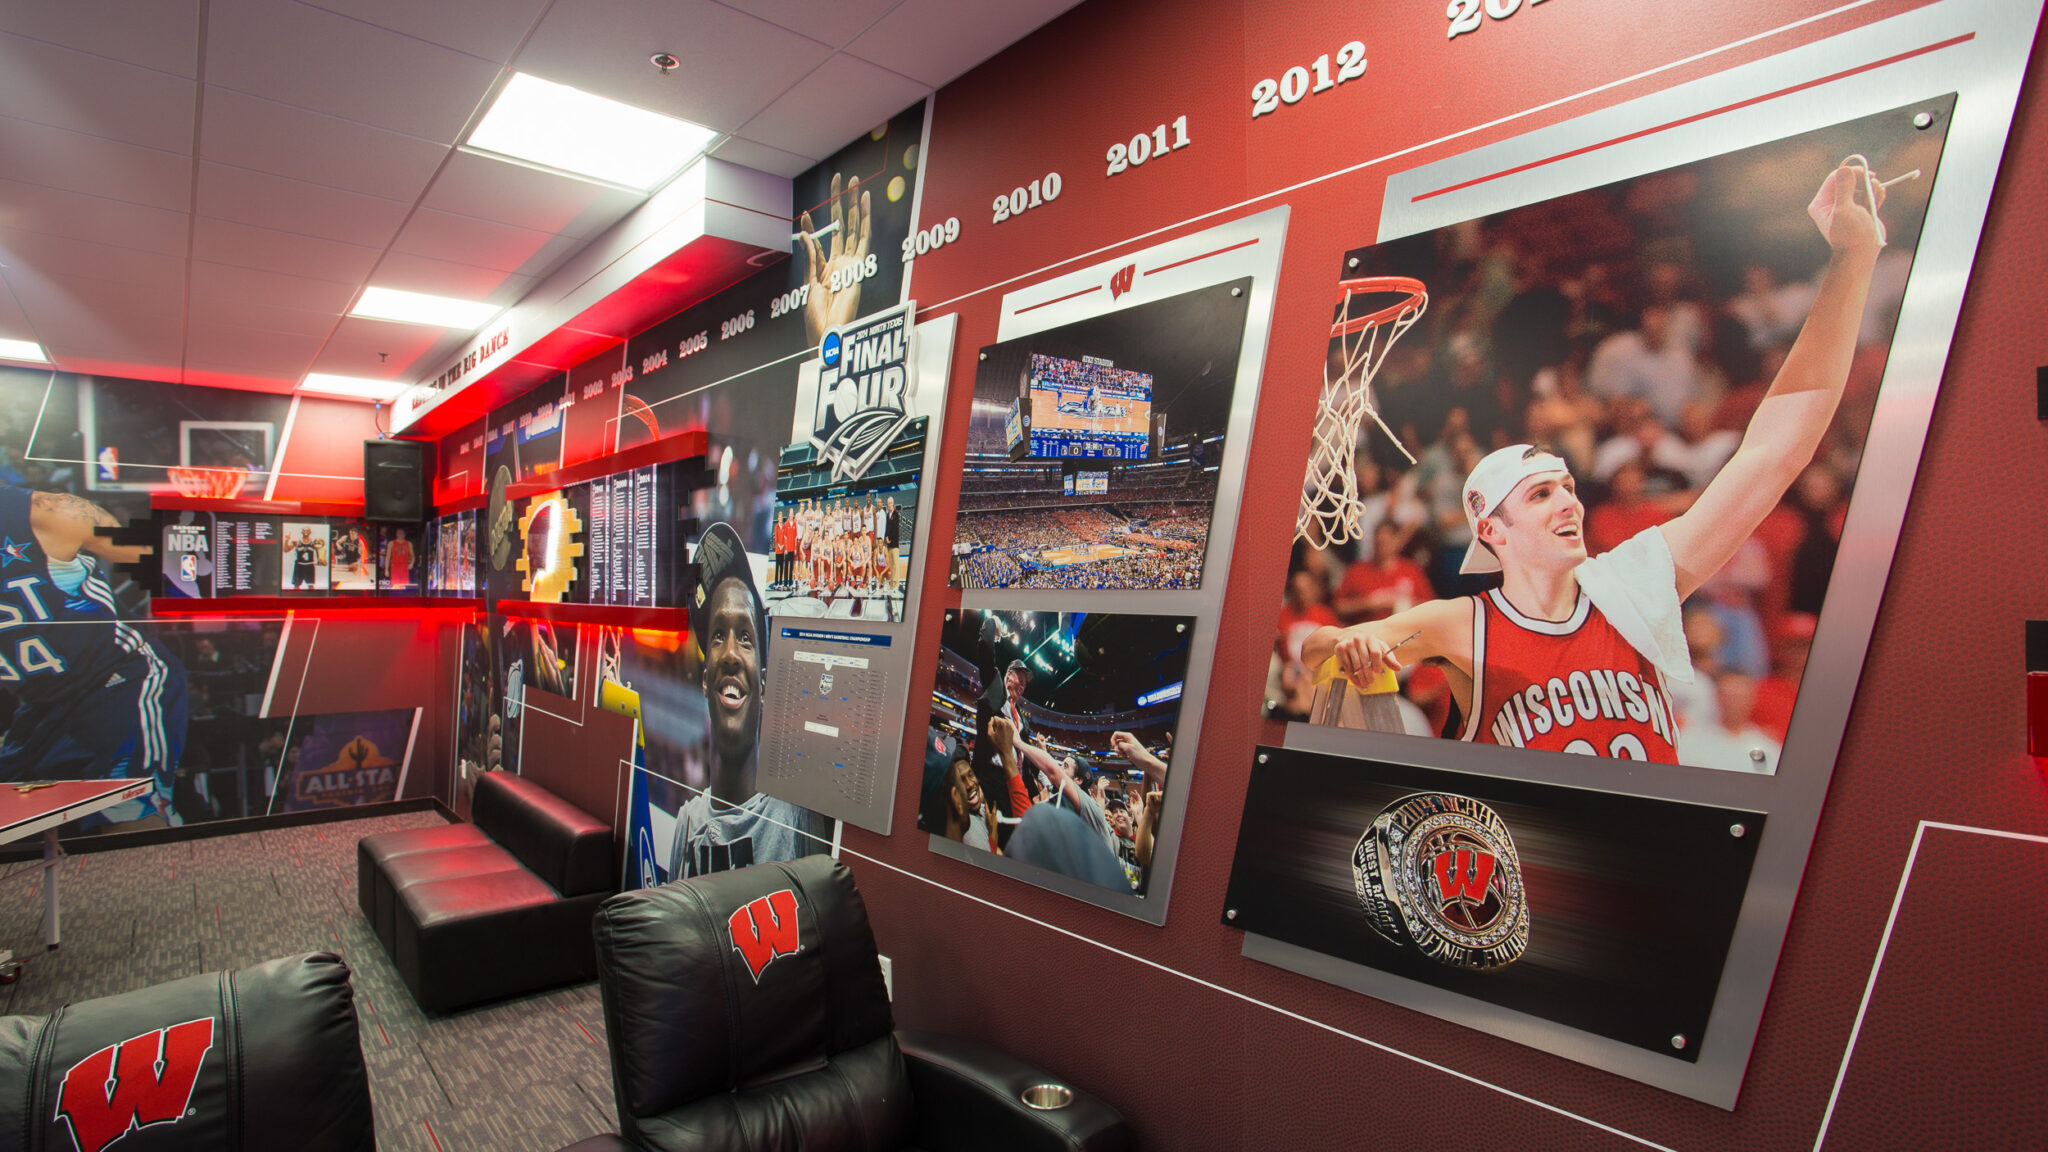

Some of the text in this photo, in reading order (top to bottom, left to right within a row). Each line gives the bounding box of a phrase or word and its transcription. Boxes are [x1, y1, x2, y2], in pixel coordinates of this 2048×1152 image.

[1252, 40, 1368, 118] 2012
[1106, 115, 1191, 176] 2011
[992, 172, 1062, 224] 2010
[902, 217, 960, 262] 2009
[830, 253, 878, 293] 2008
[1110, 264, 1136, 301] W
[771, 284, 810, 319] 2007
[679, 330, 708, 358] 2005
[721, 309, 755, 341] 2006
[642, 349, 668, 375] 2004
[839, 327, 904, 377] FINAL
[583, 379, 604, 400] 2002
[611, 365, 634, 388] 2003
[815, 366, 905, 432] FOUR
[168, 534, 209, 552] NBA
[1491, 669, 1674, 748] WISCONSN
[1439, 797, 1493, 830] NCAA
[1364, 836, 1380, 878] WEST
[1434, 846, 1497, 906] W
[728, 889, 799, 985] W
[54, 1016, 215, 1152] W
